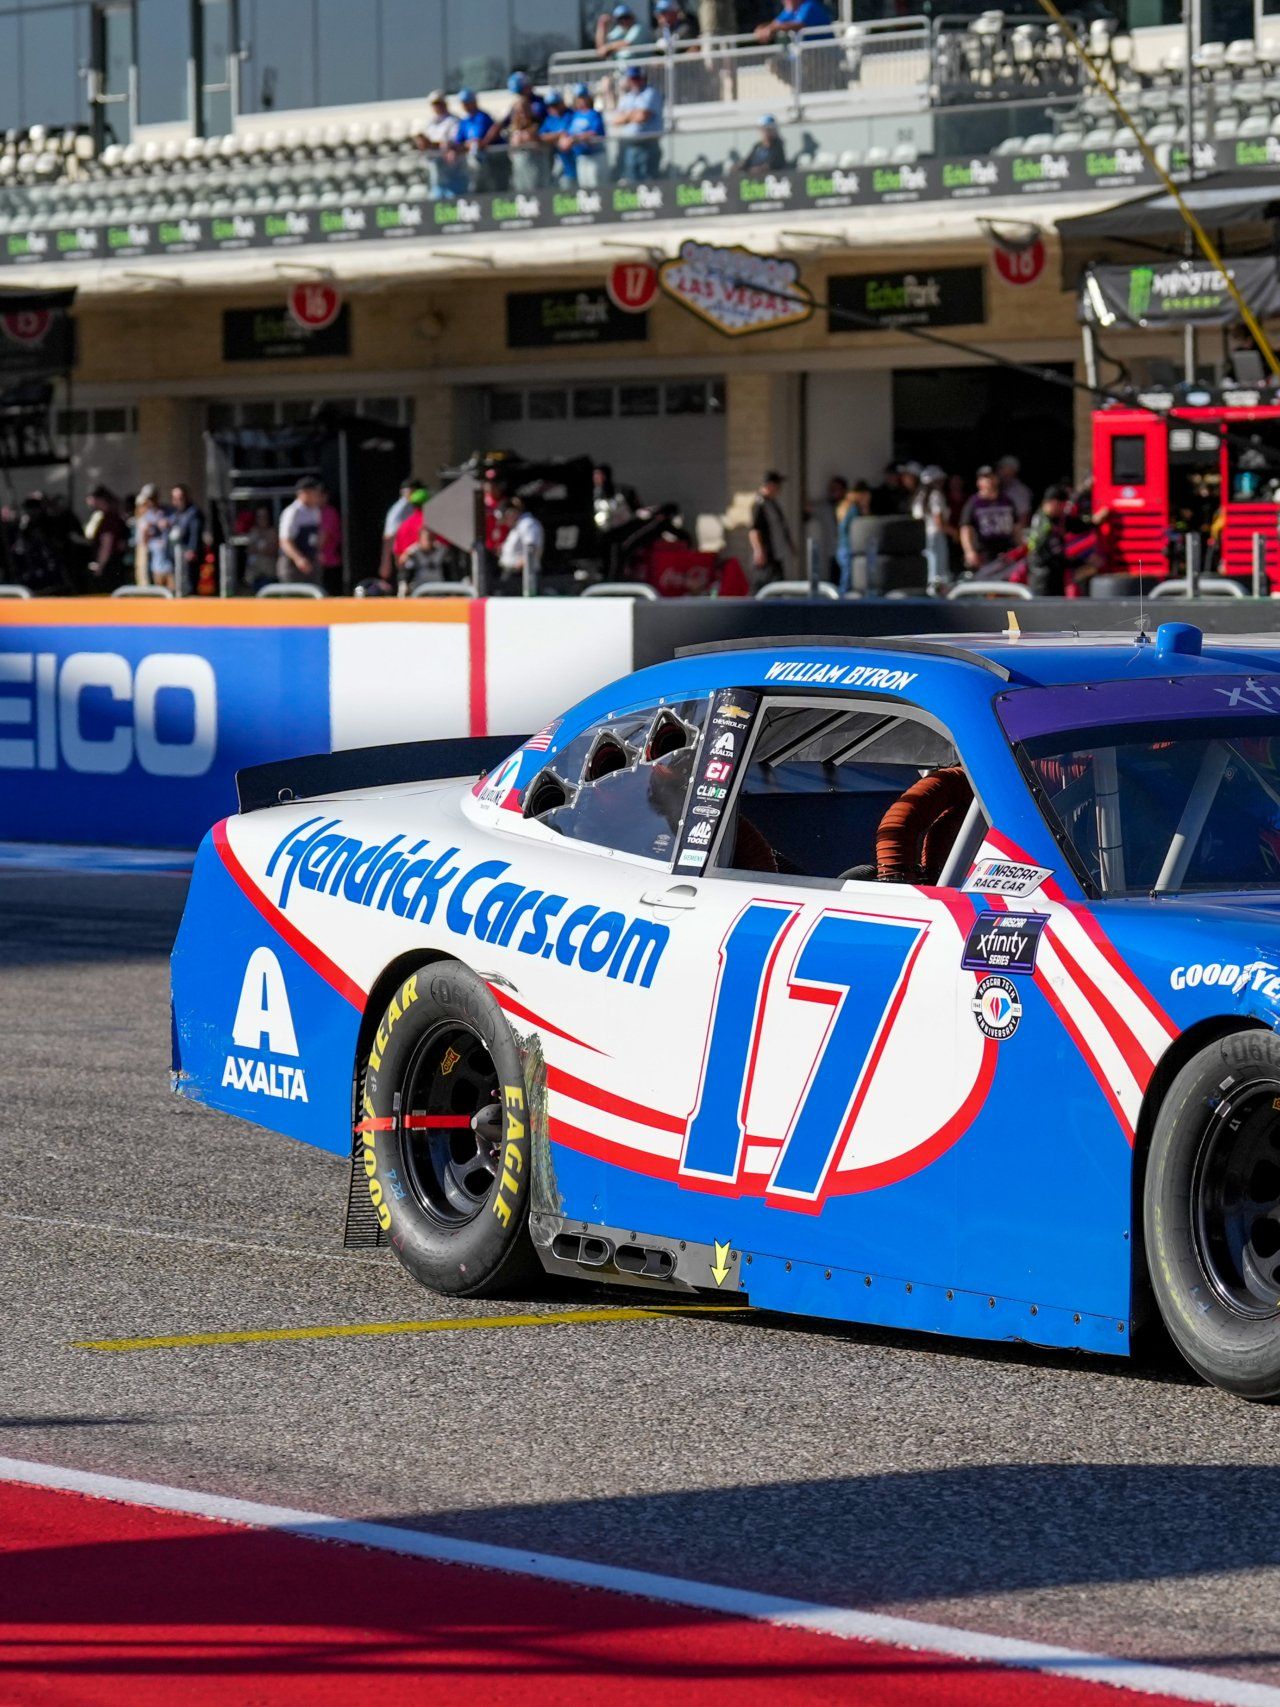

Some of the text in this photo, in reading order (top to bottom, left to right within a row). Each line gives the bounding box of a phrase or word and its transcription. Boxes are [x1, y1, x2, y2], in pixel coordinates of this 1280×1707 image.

[625, 267, 647, 300] 17
[678, 277, 714, 298] LAS
[764, 661, 918, 691] WILLIAM BYRON
[712, 718, 748, 730] CHEVROLET
[696, 785, 727, 799] CLIMB
[687, 836, 709, 846] TOOLS
[992, 864, 1039, 881] NASCAR
[973, 878, 1026, 892] RACE CAR
[1000, 917, 1028, 929] NASCAR
[976, 928, 1029, 961] xfinity
[988, 954, 1010, 966] SERIES
[978, 978, 1000, 996] NASCAR
[678, 898, 932, 1214] 17
[221, 1055, 309, 1103] AXALTA
[492, 1085, 525, 1229] EAGLE
